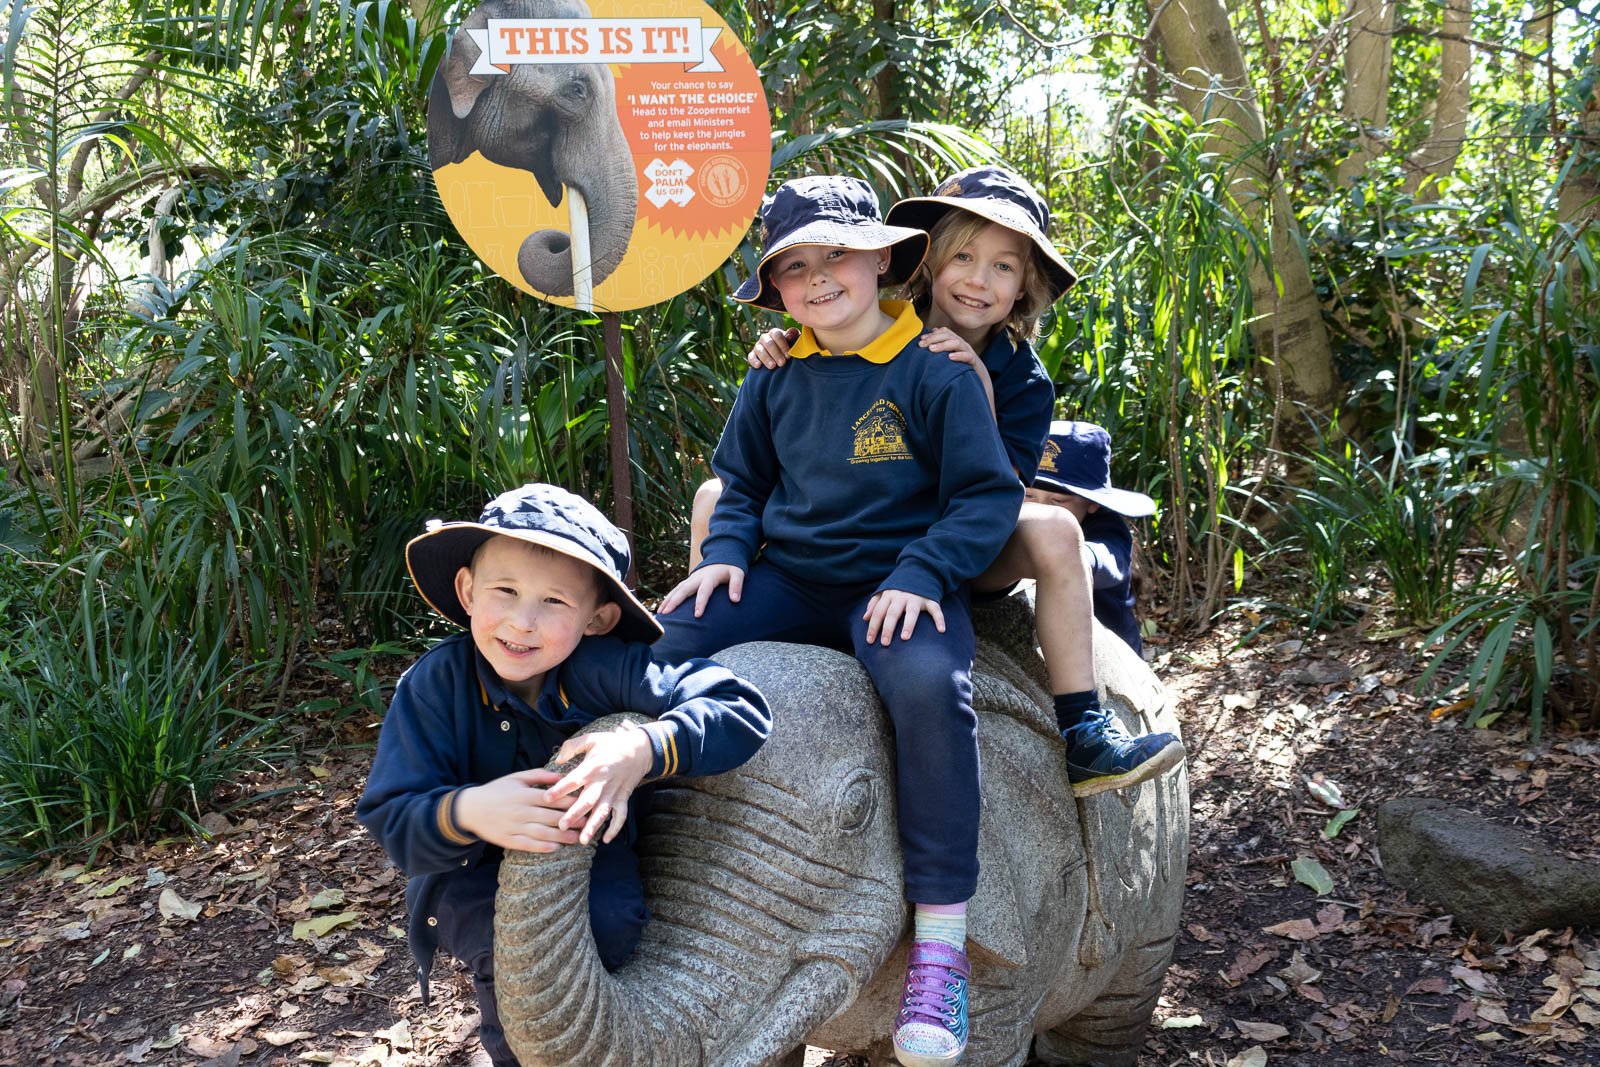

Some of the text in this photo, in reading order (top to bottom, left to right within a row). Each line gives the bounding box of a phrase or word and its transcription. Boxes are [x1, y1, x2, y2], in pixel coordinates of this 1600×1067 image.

[500, 27, 690, 55] THIS IS IT!
[651, 81, 671, 90] Your
[673, 81, 704, 89] chance
[719, 82, 734, 90] say
[640, 95, 675, 105] WANT
[680, 94, 705, 103] THE
[632, 108, 655, 116] Head
[670, 107, 684, 115] the
[688, 105, 750, 116] Zoopermarket
[648, 118, 734, 127] and email Ministers
[640, 132, 649, 140] to
[652, 131, 671, 141] help
[673, 131, 694, 140] keep
[714, 129, 745, 139] jungles
[654, 141, 733, 151] for the elephants.
[655, 178, 684, 186] PALM
[851, 399, 885, 431] LANCEFIELD
